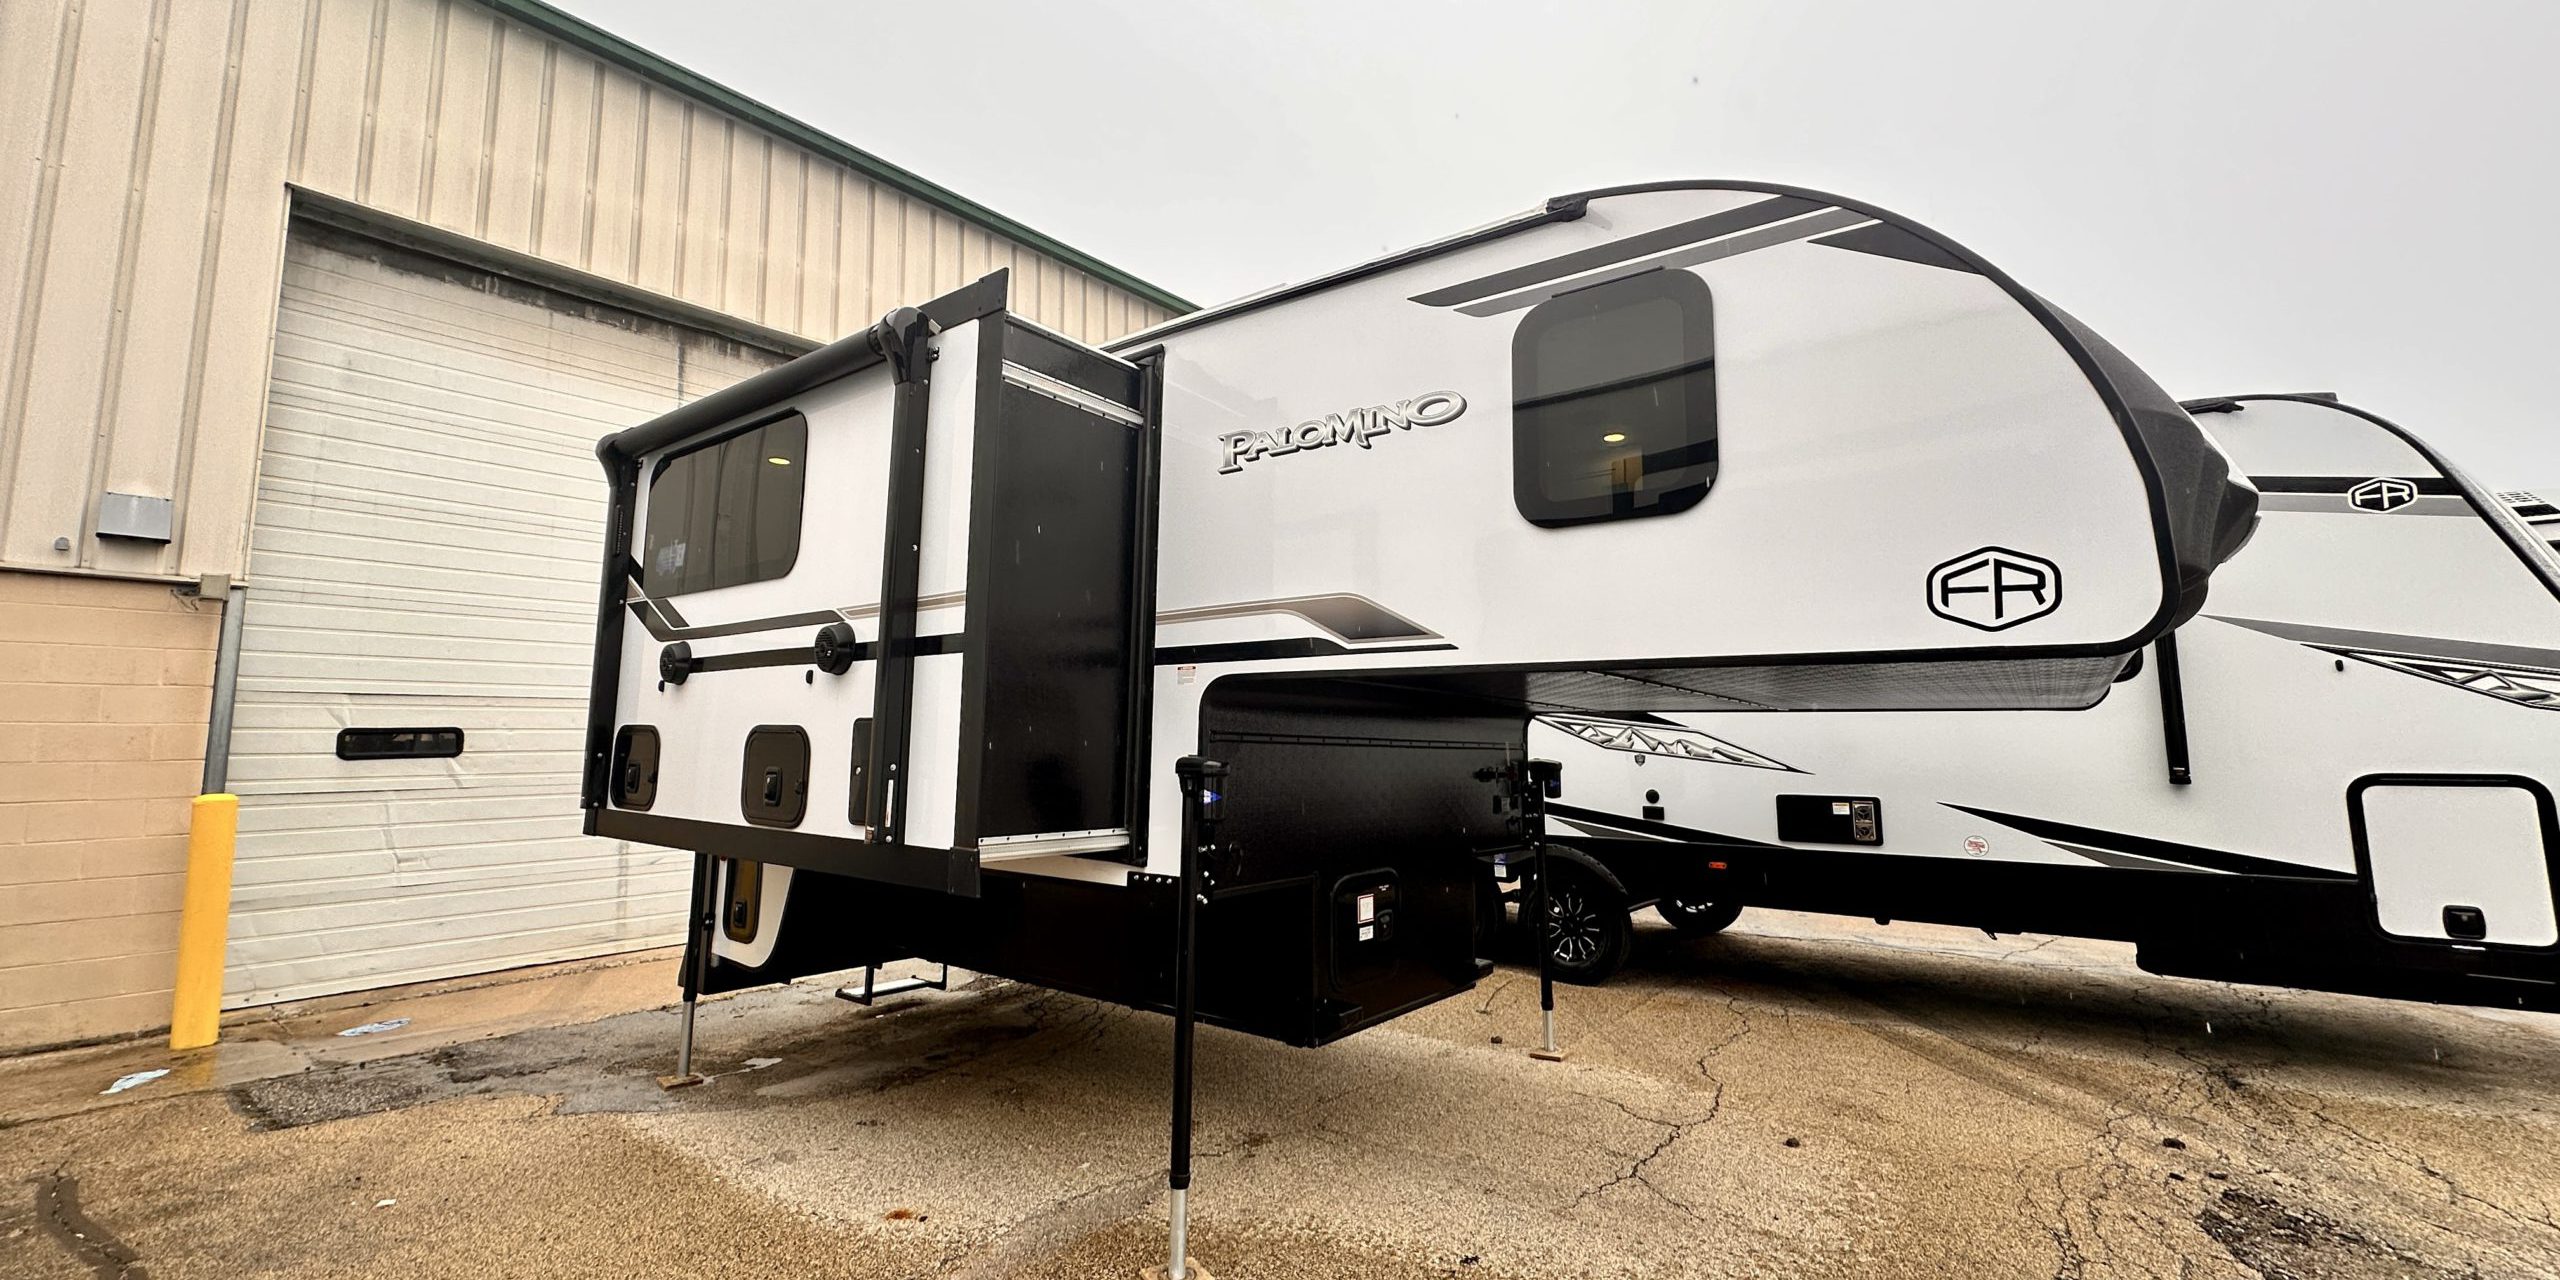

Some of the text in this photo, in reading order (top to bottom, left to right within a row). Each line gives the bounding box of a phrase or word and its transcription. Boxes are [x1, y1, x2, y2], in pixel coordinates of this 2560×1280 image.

[1218, 390, 1467, 475] PALOMINO
[2354, 482, 2411, 509] FR
[1940, 557, 2047, 620] FR
